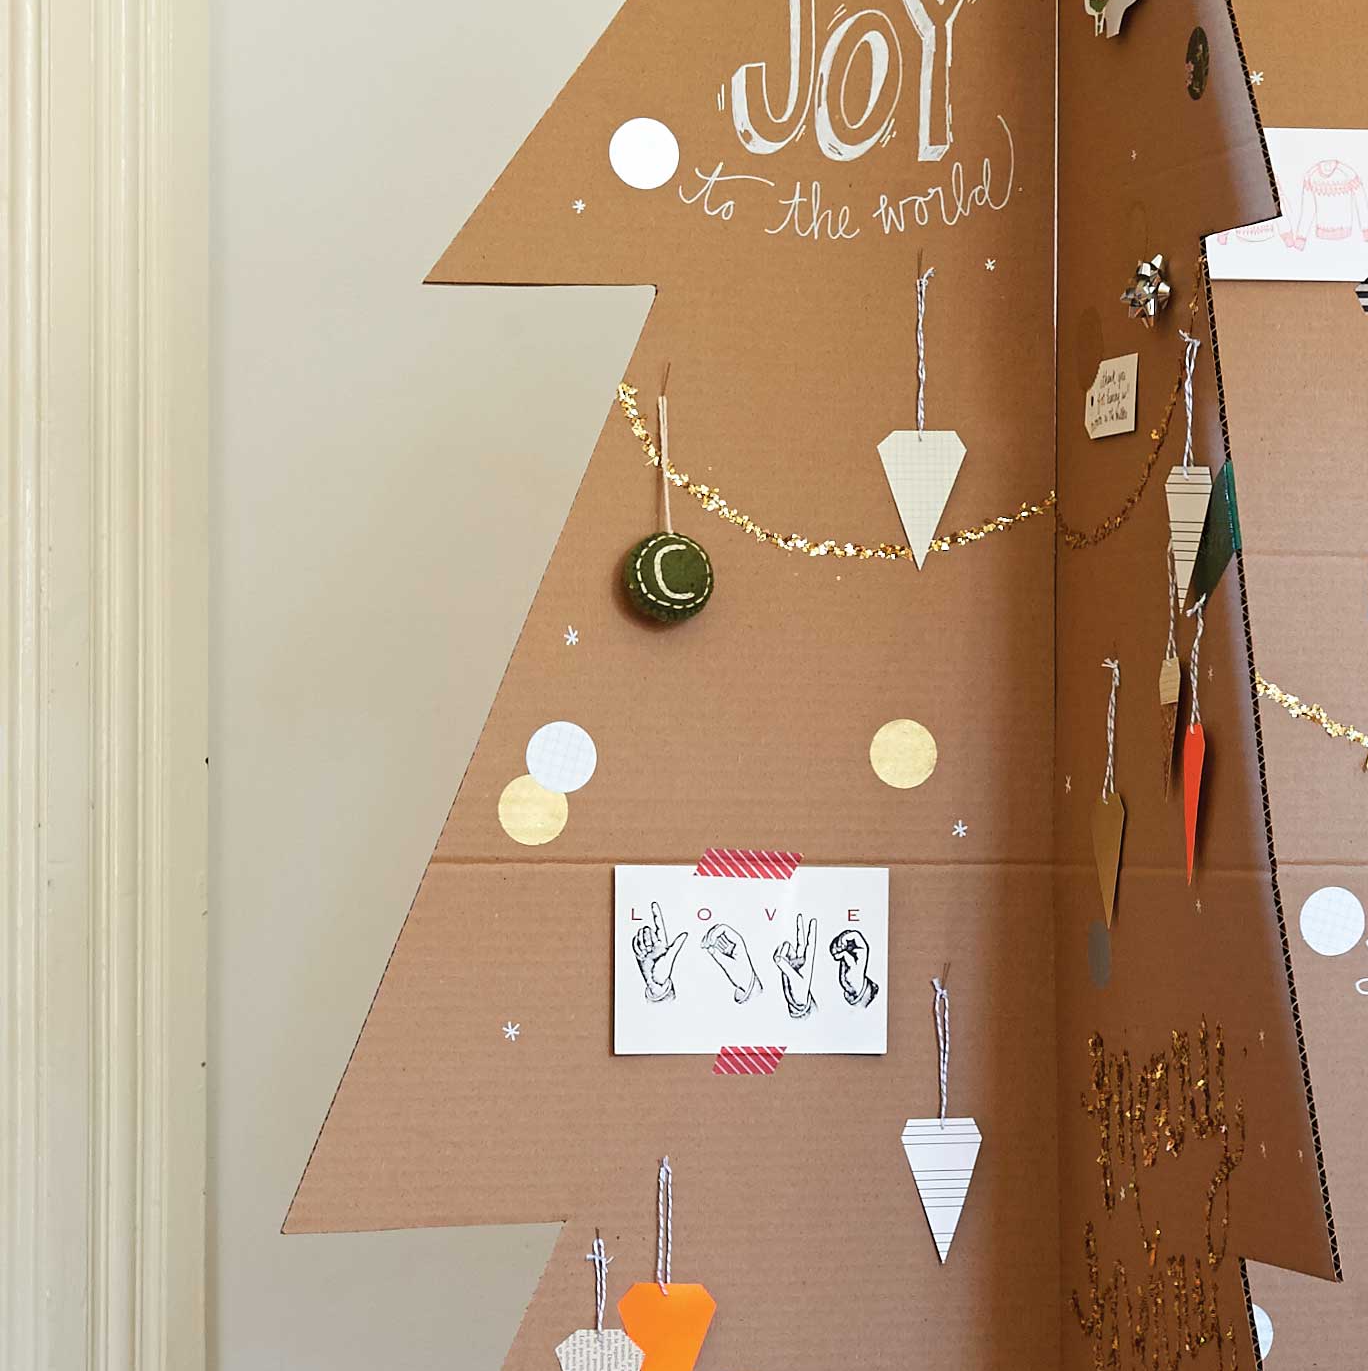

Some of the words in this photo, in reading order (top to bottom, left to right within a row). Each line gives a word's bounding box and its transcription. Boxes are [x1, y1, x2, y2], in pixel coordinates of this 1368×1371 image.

[679, 162, 775, 221] to
[765, 181, 860, 241] the
[873, 115, 1015, 235] world
[653, 544, 695, 600] C
